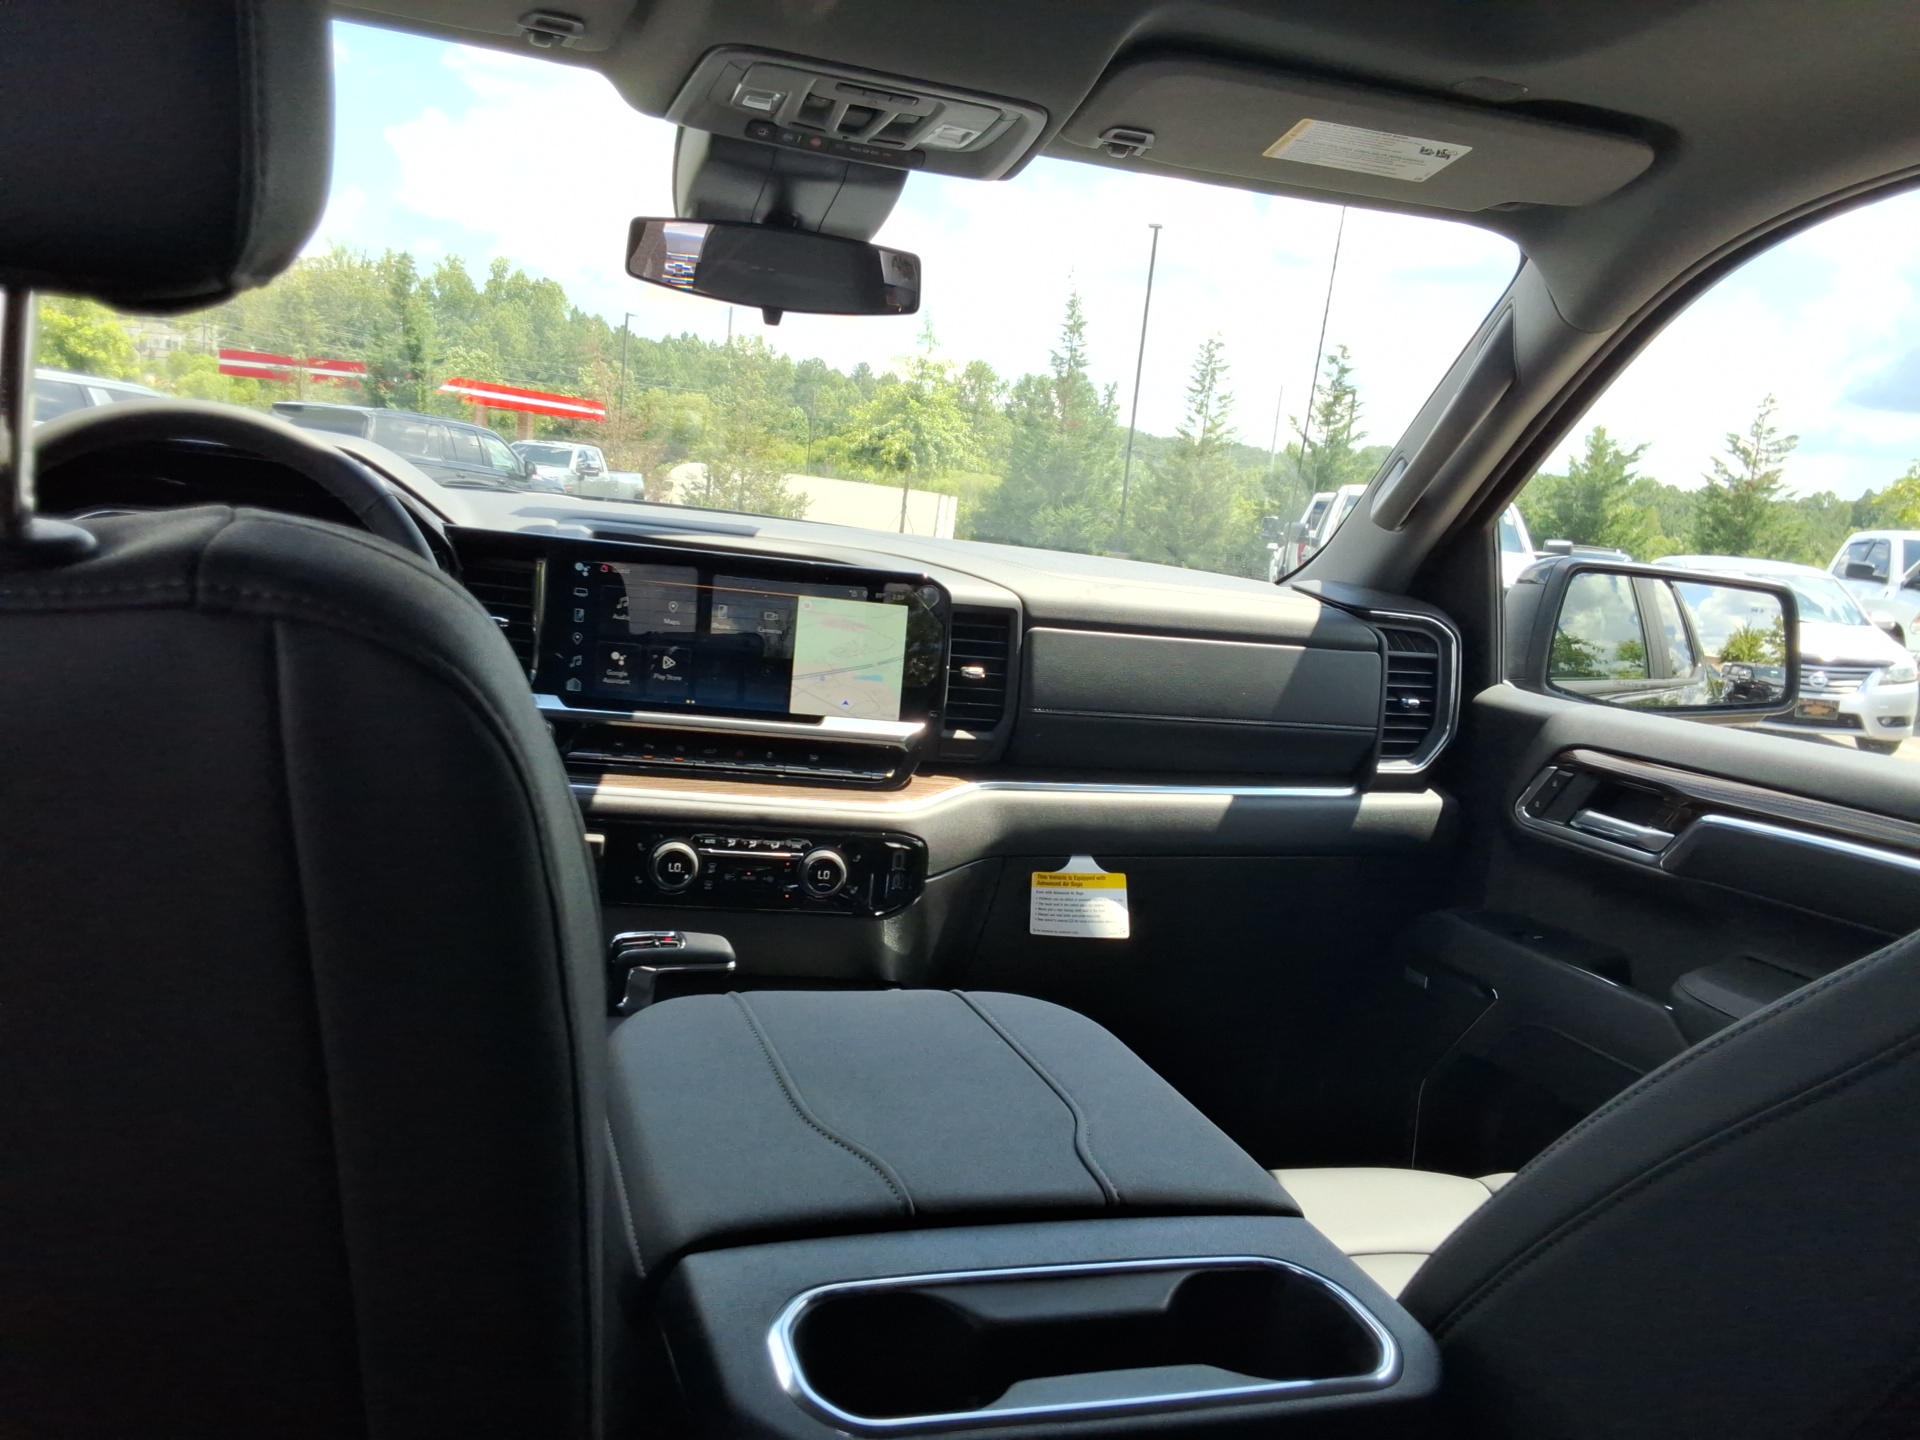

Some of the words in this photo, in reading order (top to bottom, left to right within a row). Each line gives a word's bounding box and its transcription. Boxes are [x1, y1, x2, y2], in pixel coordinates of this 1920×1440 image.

[663, 618, 681, 626] Maps
[606, 669, 629, 678] Google
[653, 672, 666, 681] Play
[666, 673, 683, 681] Store
